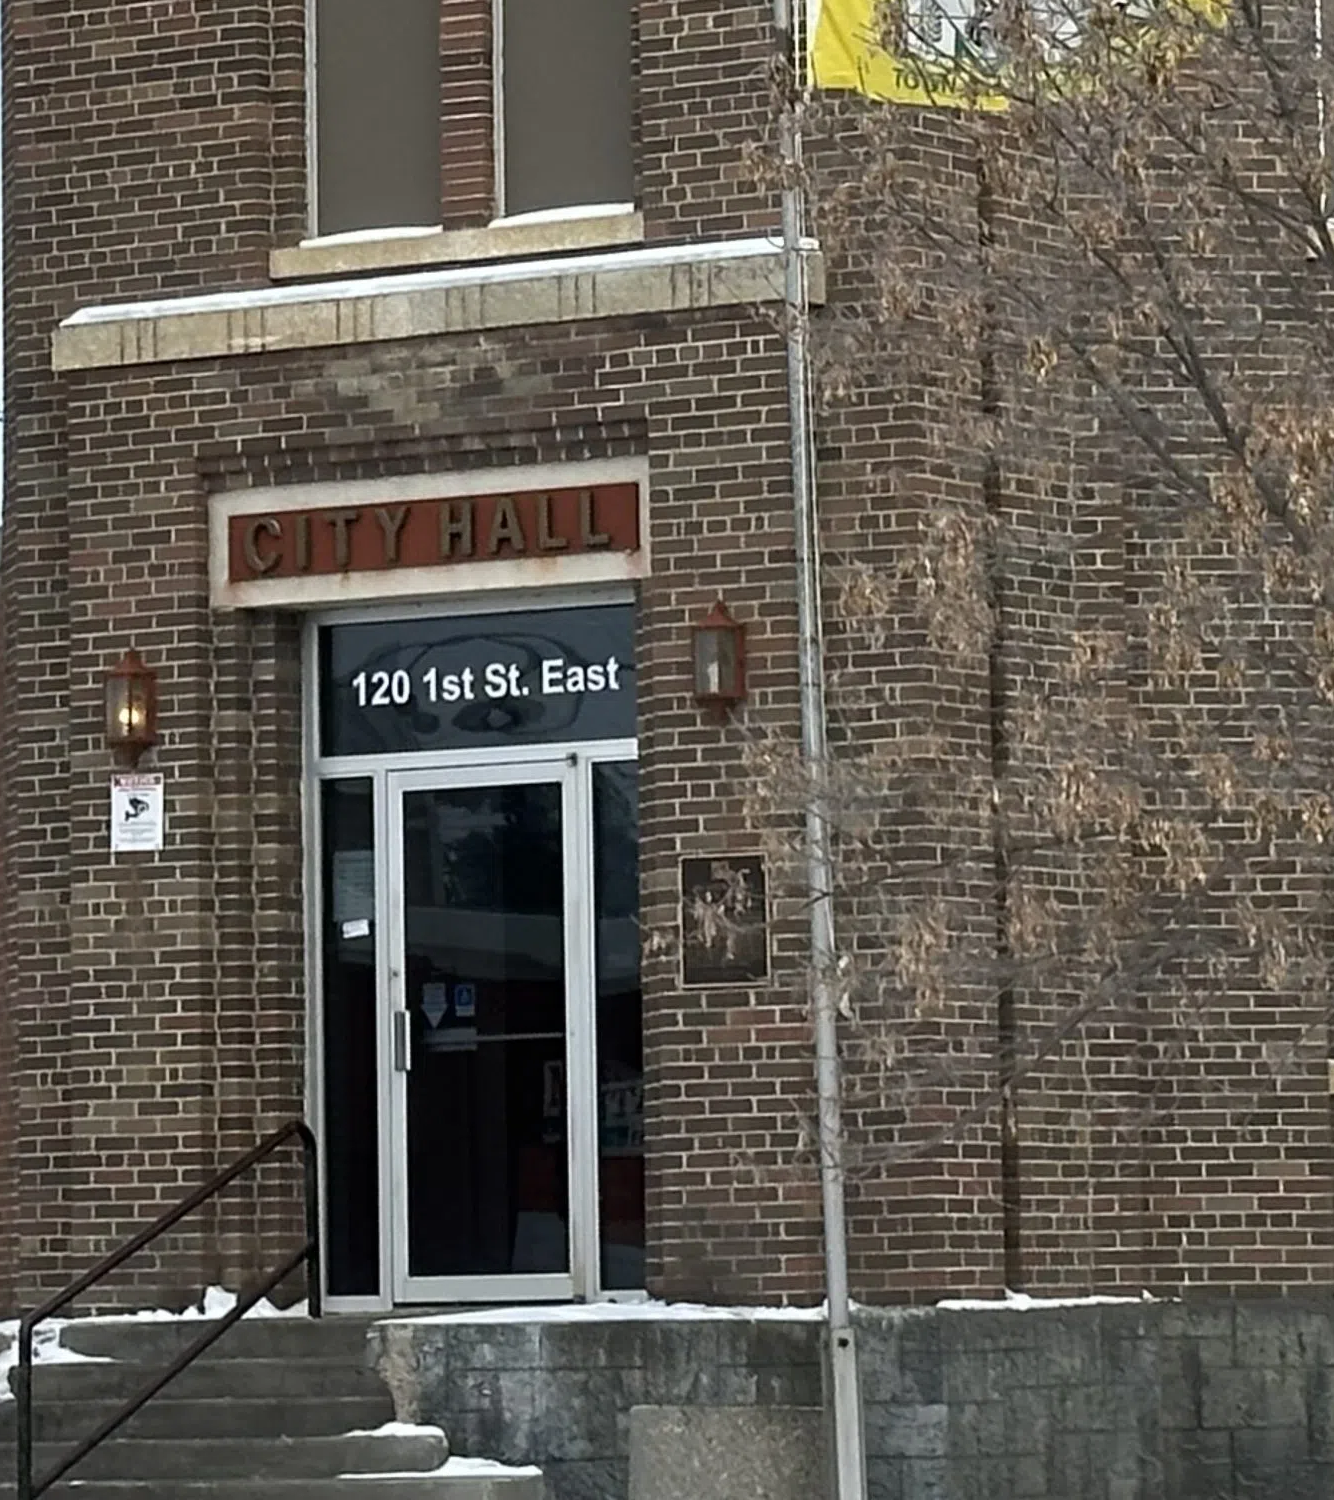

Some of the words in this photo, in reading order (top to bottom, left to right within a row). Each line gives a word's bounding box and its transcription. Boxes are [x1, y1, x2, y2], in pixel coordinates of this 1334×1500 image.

[244, 506, 412, 573] CITY
[440, 489, 611, 558] HALL
[352, 670, 411, 707] 120
[423, 666, 475, 702] 1st
[484, 662, 530, 698] St.
[542, 656, 620, 695] East
